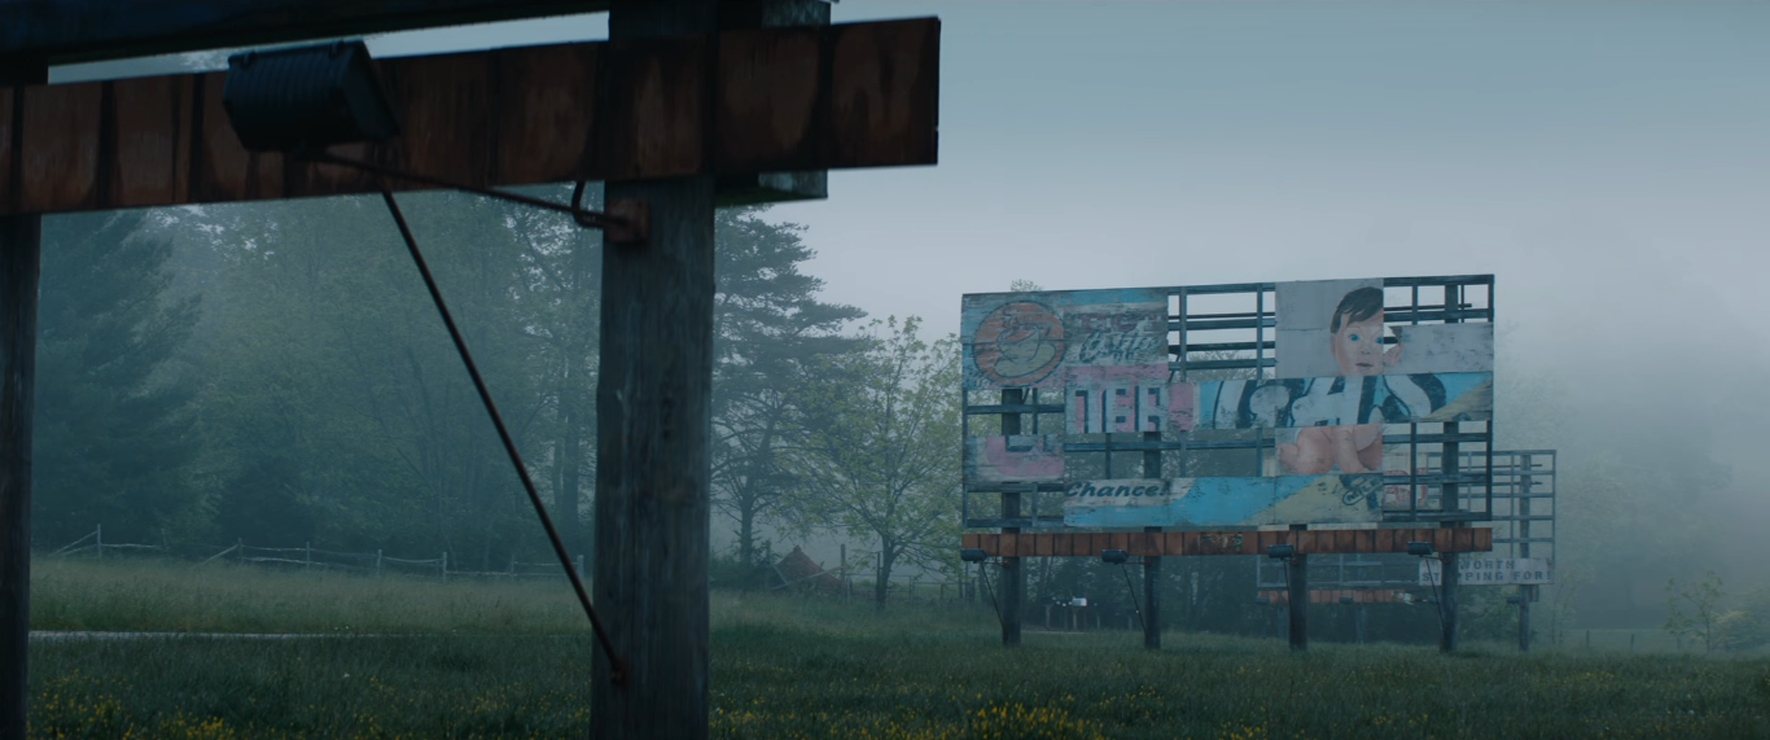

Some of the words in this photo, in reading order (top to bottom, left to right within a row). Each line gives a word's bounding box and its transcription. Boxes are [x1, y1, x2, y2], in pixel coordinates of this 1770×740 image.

[1064, 482, 1171, 498] Chance!
[1459, 560, 1515, 570] WORTH
[1422, 571, 1504, 581] STPING
